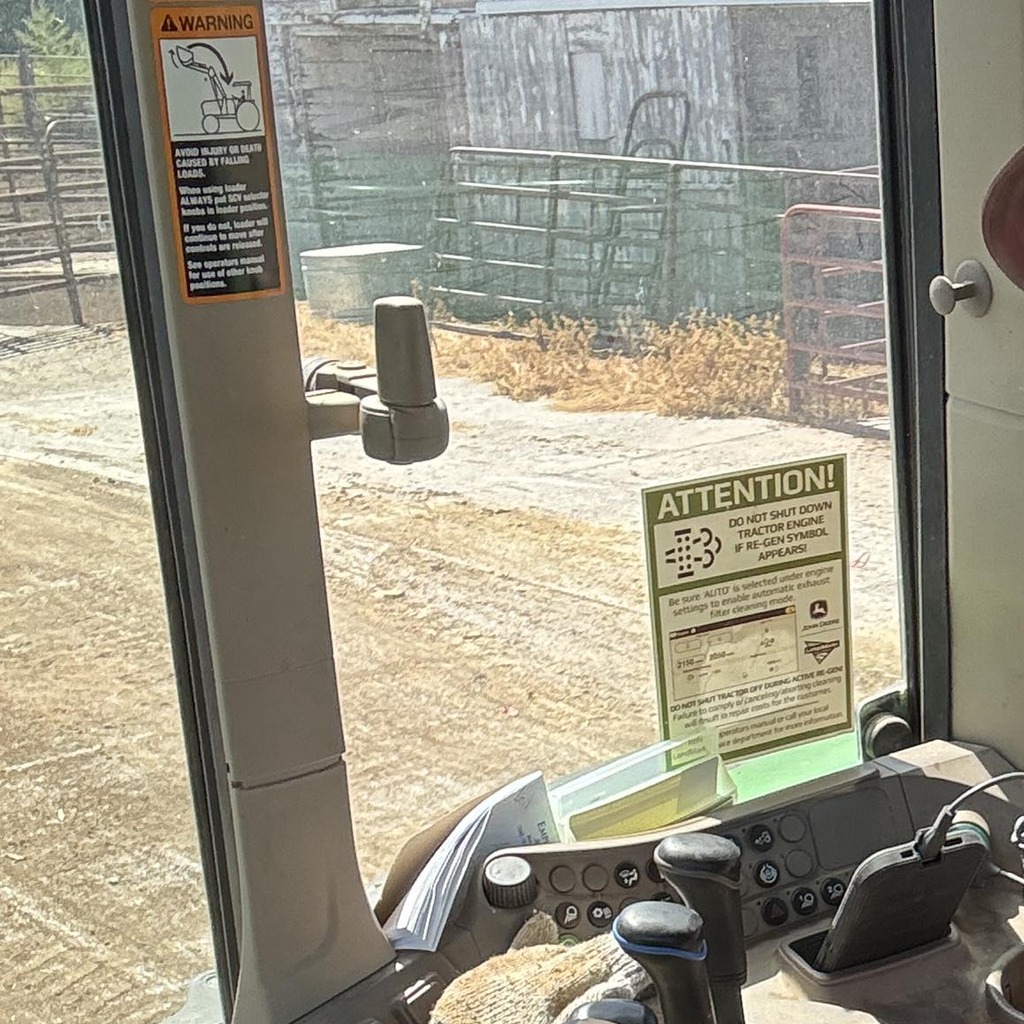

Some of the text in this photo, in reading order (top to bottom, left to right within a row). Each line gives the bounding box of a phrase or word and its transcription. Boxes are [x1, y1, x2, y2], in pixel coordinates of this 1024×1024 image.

[179, 14, 254, 31] WARNING
[175, 144, 262, 157] AVOID INJURY OR DEATH
[176, 155, 249, 168] CAUSED BY FALLING
[179, 186, 201, 194] When
[224, 183, 246, 192] loader
[181, 196, 213, 205] ALWAYS
[191, 225, 206, 234] you
[207, 223, 216, 231] do
[234, 219, 255, 228] loader
[658, 464, 834, 520] ATTENTION!
[729, 501, 832, 528] DO NOT SHUT DOWN
[738, 515, 824, 539] TRACTOR ENGINE
[735, 528, 828, 553] IF RE-GEN SYMBOL
[758, 544, 807, 561] APPEARS!
[669, 598, 680, 606] Be
[682, 594, 700, 604] sure
[742, 578, 777, 590] selected
[779, 572, 803, 582] under
[805, 566, 833, 578] engine
[673, 577, 830, 617] settings to enable automatic exhaust
[710, 608, 730, 619] filter
[732, 600, 767, 614] cleaning
[673, 710, 698, 721] Failure
[708, 701, 734, 712] comply
[813, 676, 841, 687] cleaning
[682, 700, 696, 708] NOT
[698, 696, 716, 706] SHUT
[717, 688, 749, 700] TRACTOR
[750, 684, 763, 692] OFF
[765, 677, 791, 689] DURING
[792, 672, 815, 682] ACTIVE
[729, 708, 749, 718] repair
[750, 718, 776, 729] manual
[785, 712, 797, 721] call
[798, 709, 812, 718] your
[814, 704, 829, 713] local
[733, 729, 772, 744] department
[785, 722, 802, 730] more
